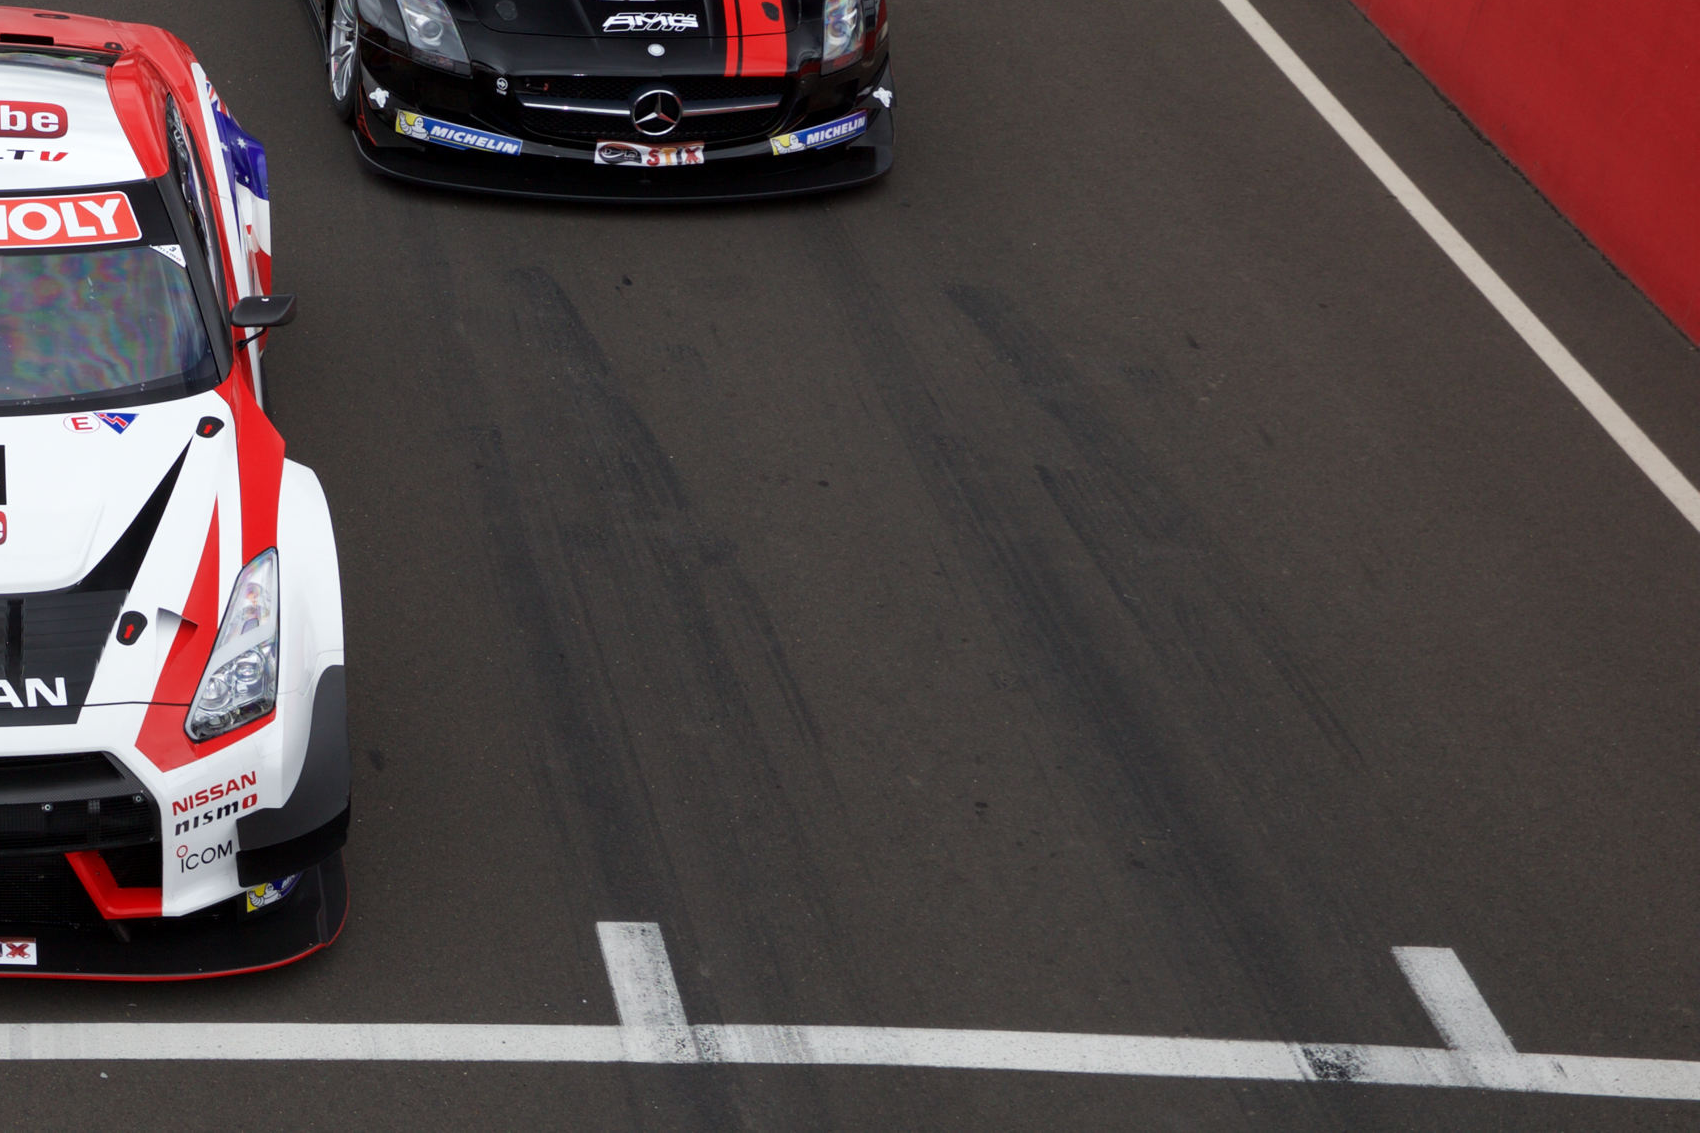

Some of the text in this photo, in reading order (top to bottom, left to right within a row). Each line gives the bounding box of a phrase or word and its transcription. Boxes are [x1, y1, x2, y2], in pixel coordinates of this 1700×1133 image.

[602, 14, 699, 29] AMG
[430, 125, 519, 155] MICHELIN
[806, 116, 866, 146] MICHELIN
[646, 146, 700, 166] STIX
[70, 416, 93, 431] E
[172, 770, 258, 816] NISSAN
